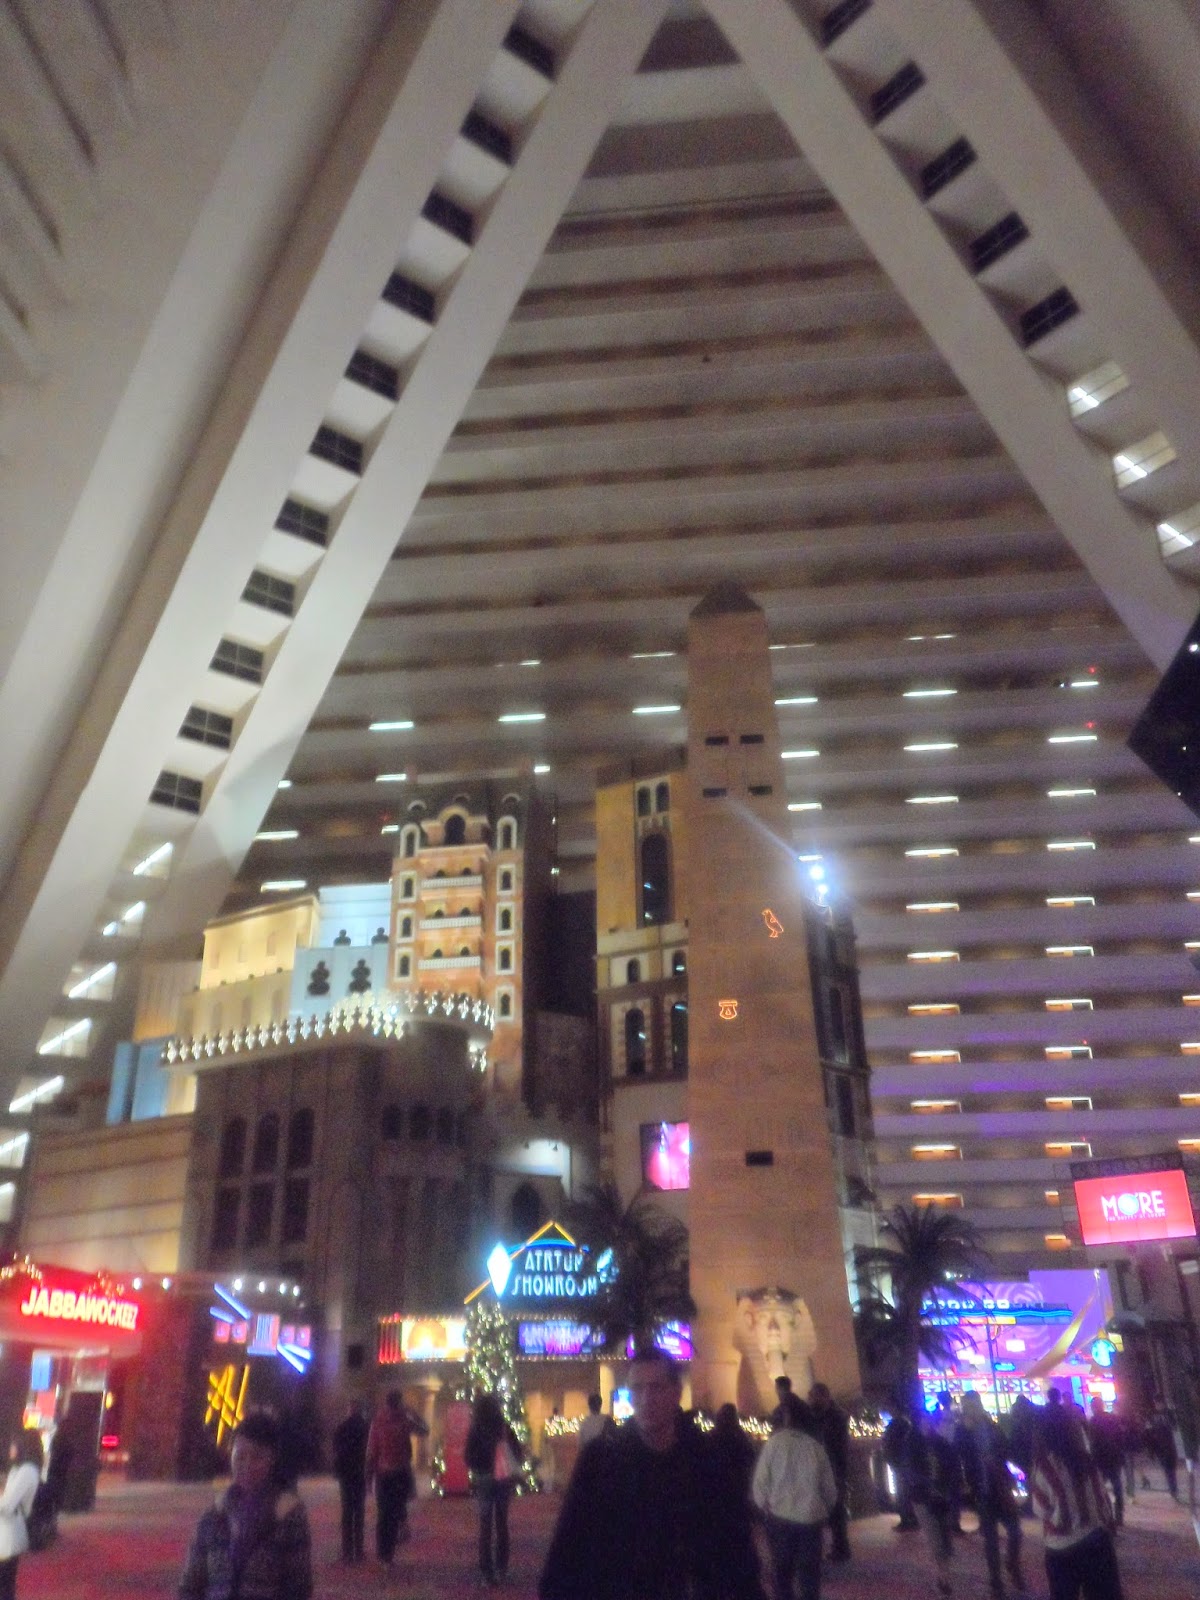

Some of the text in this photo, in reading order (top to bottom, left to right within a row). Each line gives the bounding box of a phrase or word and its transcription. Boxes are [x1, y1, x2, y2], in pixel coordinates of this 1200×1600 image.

[1100, 1190, 1166, 1222] MORE
[511, 1274, 597, 1296] SHOWROOM
[21, 1286, 139, 1331] JABBAWOCKEEZ
